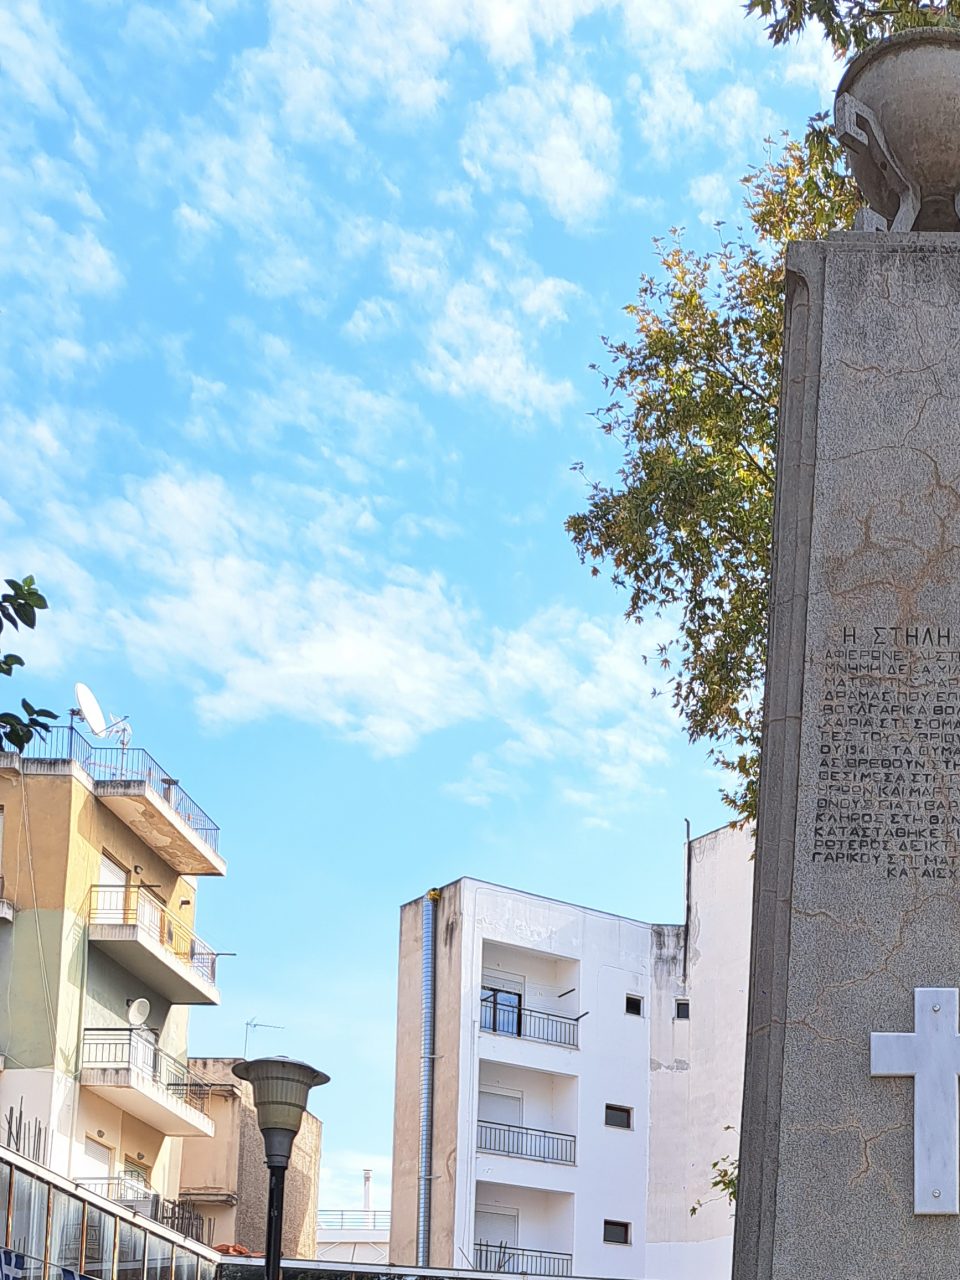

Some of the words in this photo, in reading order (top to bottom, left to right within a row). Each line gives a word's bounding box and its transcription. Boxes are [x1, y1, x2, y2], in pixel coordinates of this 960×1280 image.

[843, 626, 857, 645] Η
[873, 626, 951, 647] ΣΤΗΛΗ
[824, 662, 881, 675] ΜΝΗΜΗ
[887, 663, 931, 675] ΔΕΚΑ
[824, 690, 891, 702] ΔΡΑΜΑΣ
[897, 691, 930, 703] ΠΟΥ
[823, 702, 928, 716] ΒΟΥΛΓΑΡΙΚΑ
[822, 717, 873, 729] ΧΑΙΡΙΑ
[820, 731, 853, 742] ΓΕΣ
[860, 731, 890, 743] ΤΟΥ
[820, 744, 841, 755] ΟΥ
[892, 745, 913, 756] ΤΑ
[819, 758, 842, 769] ΑΣ
[847, 758, 926, 770] ΒΡΕΘΟΥΝ
[819, 771, 857, 782] ΘΕΣΙ
[860, 772, 906, 784] ΜΕΣΑ
[878, 785, 905, 798] ΚΑΙ
[815, 812, 884, 824] ΚΛΗΡΟΣ
[889, 813, 924, 825] ΣΤΗ
[814, 825, 940, 839] ΚΑΤΑΣΤΑΘΗΚΕ
[813, 839, 890, 852] ΡΩΤΕΡΟΣ
[811, 851, 881, 865] ΓΑΡΙΚΟΥ
